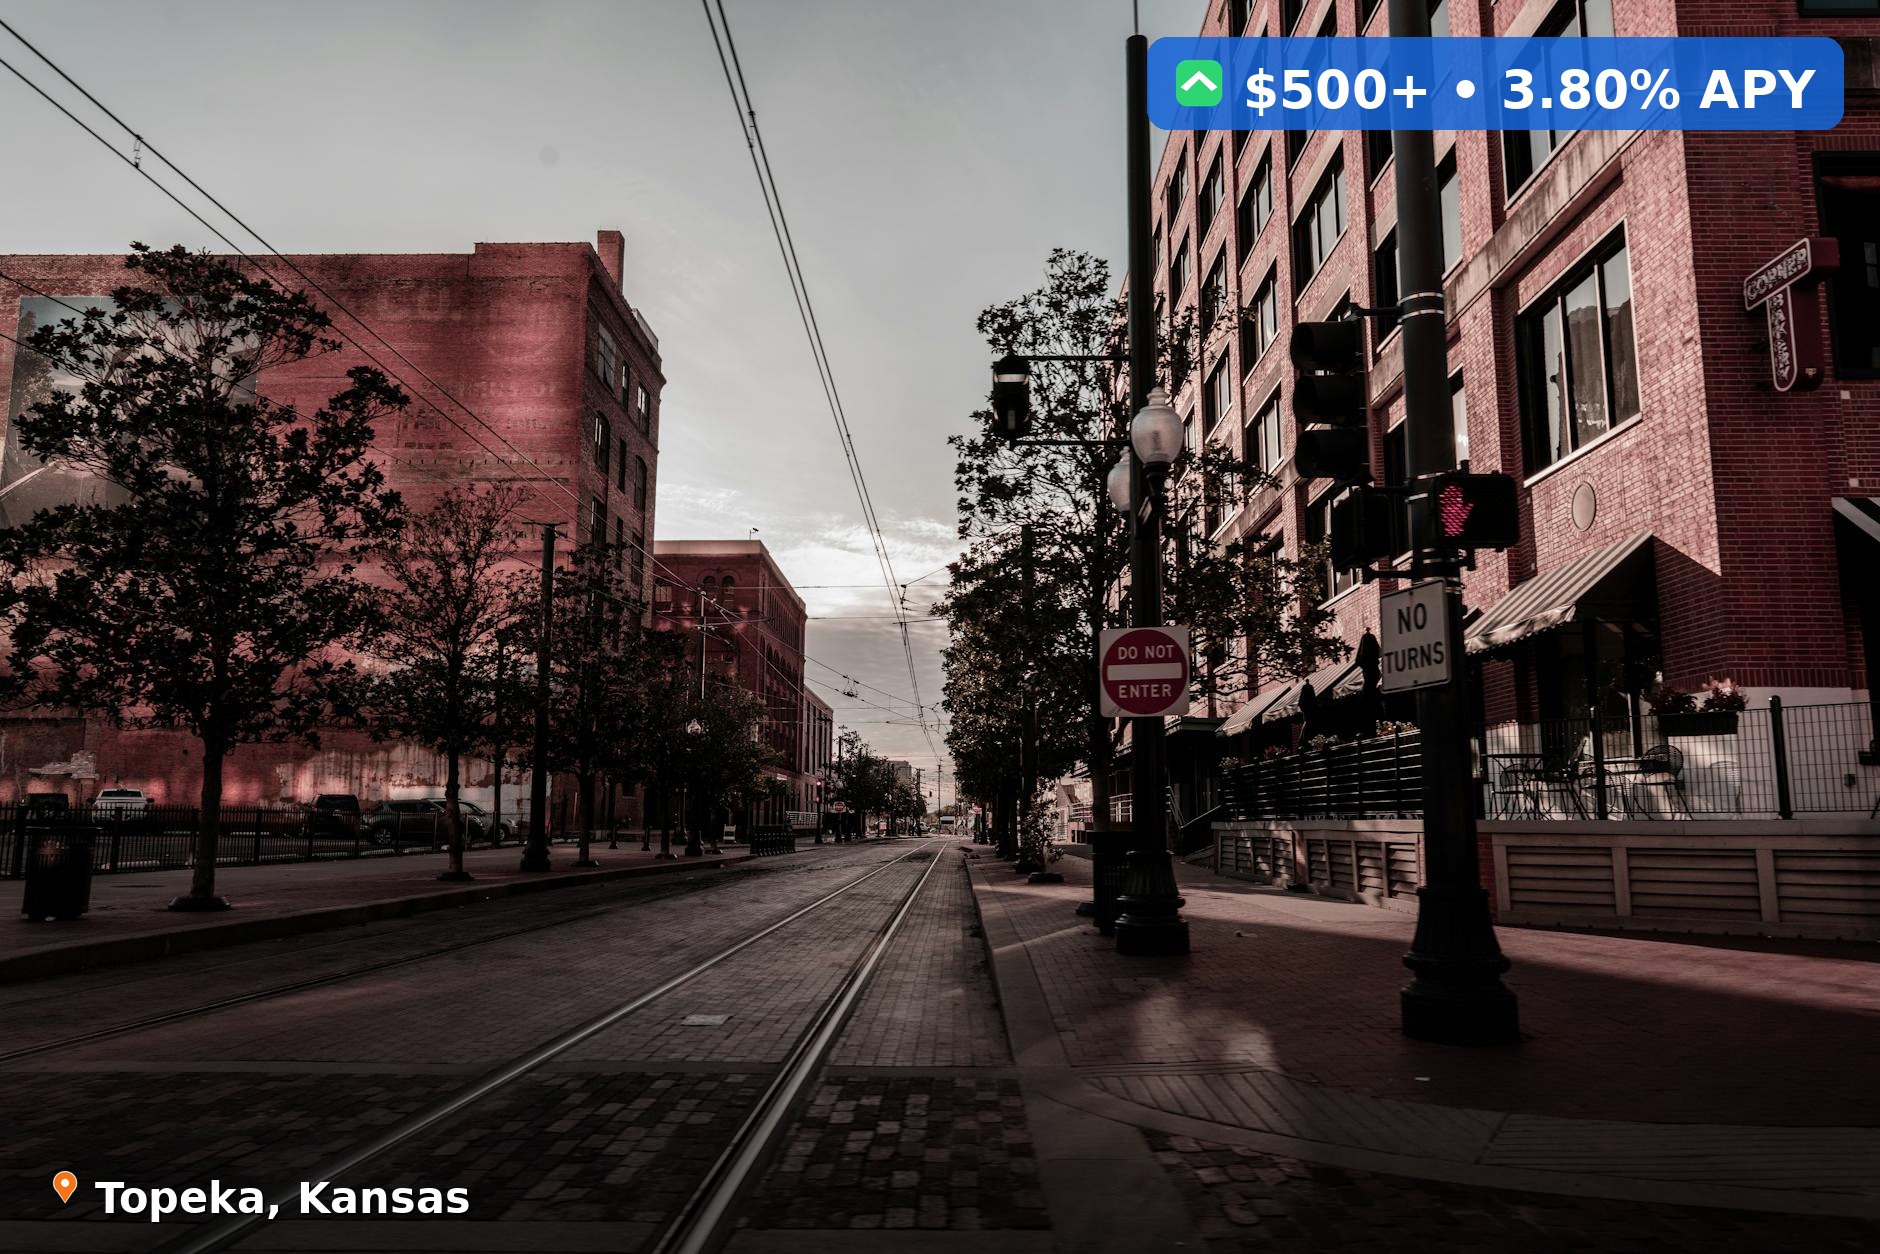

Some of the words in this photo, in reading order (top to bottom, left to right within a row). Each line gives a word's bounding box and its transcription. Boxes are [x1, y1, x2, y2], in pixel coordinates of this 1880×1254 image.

[1746, 247, 1808, 301] CORNER
[1770, 292, 1791, 383] BAKERY
[1398, 603, 1427, 634] NO
[1117, 646, 1138, 660] DO
[1144, 644, 1174, 659] NOT
[1384, 641, 1444, 674] TURNS
[1118, 683, 1172, 699] ENTER
